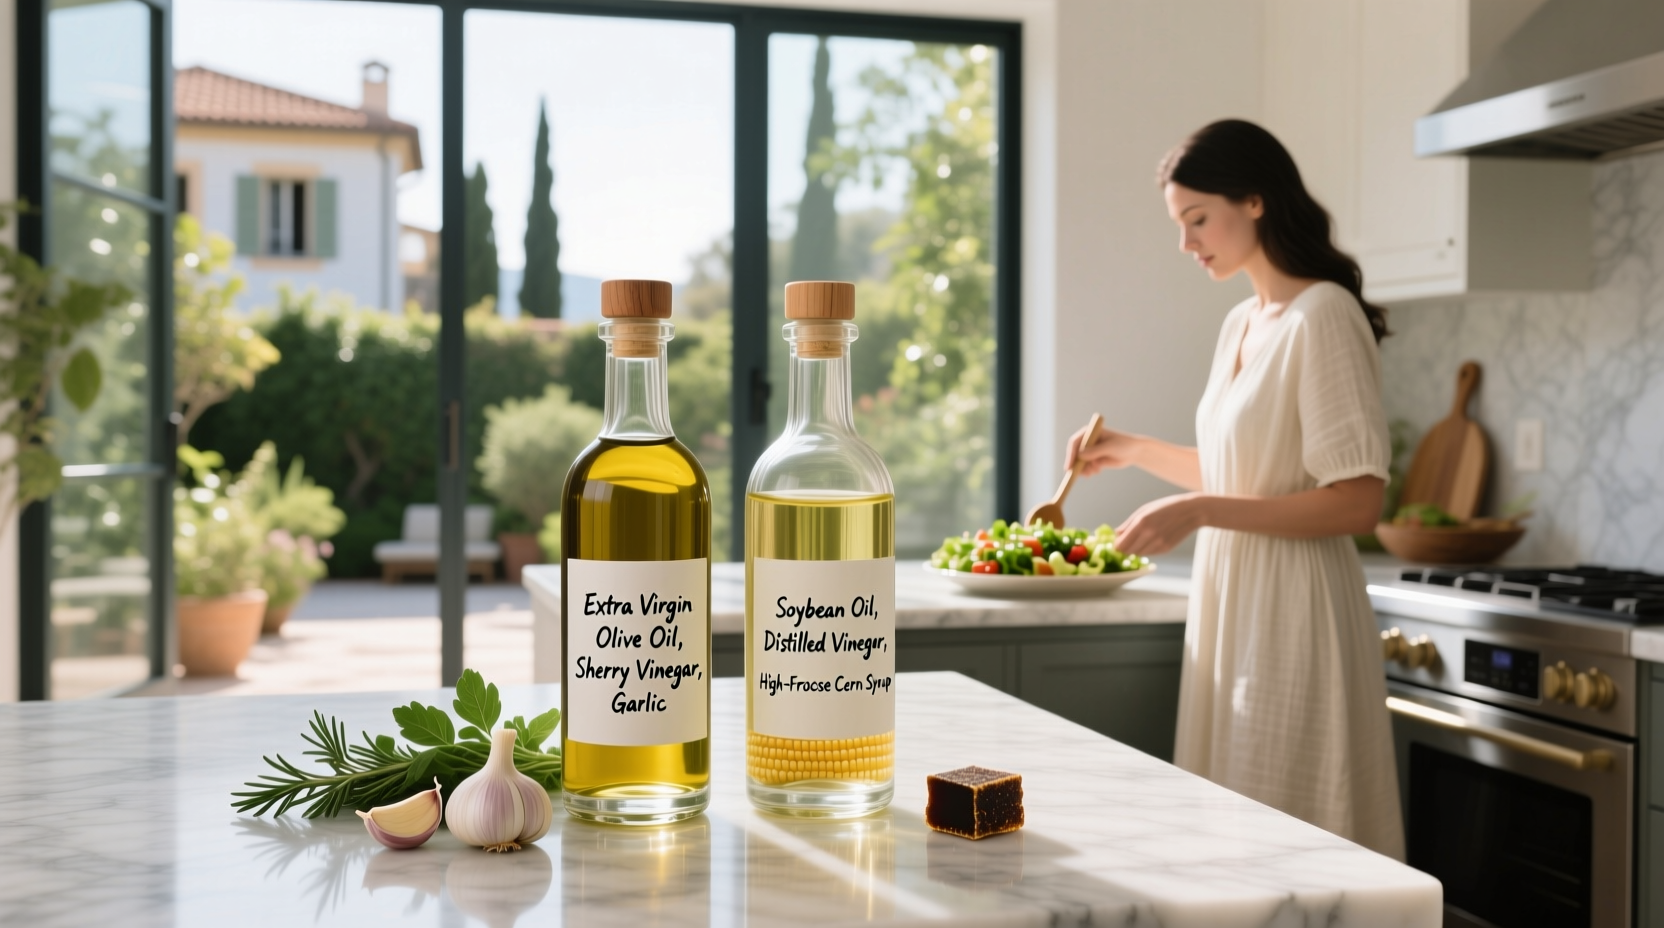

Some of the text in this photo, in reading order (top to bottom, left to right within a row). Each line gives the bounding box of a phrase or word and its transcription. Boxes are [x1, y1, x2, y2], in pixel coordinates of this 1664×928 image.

[583, 592, 693, 624] Extra Virgin
[775, 594, 878, 628] Soybean Oil,
[595, 624, 683, 652] Olive Oil,
[764, 629, 827, 653] Distilled
[575, 655, 703, 690] Sherry Vinegar,
[611, 691, 667, 715] Garlic
